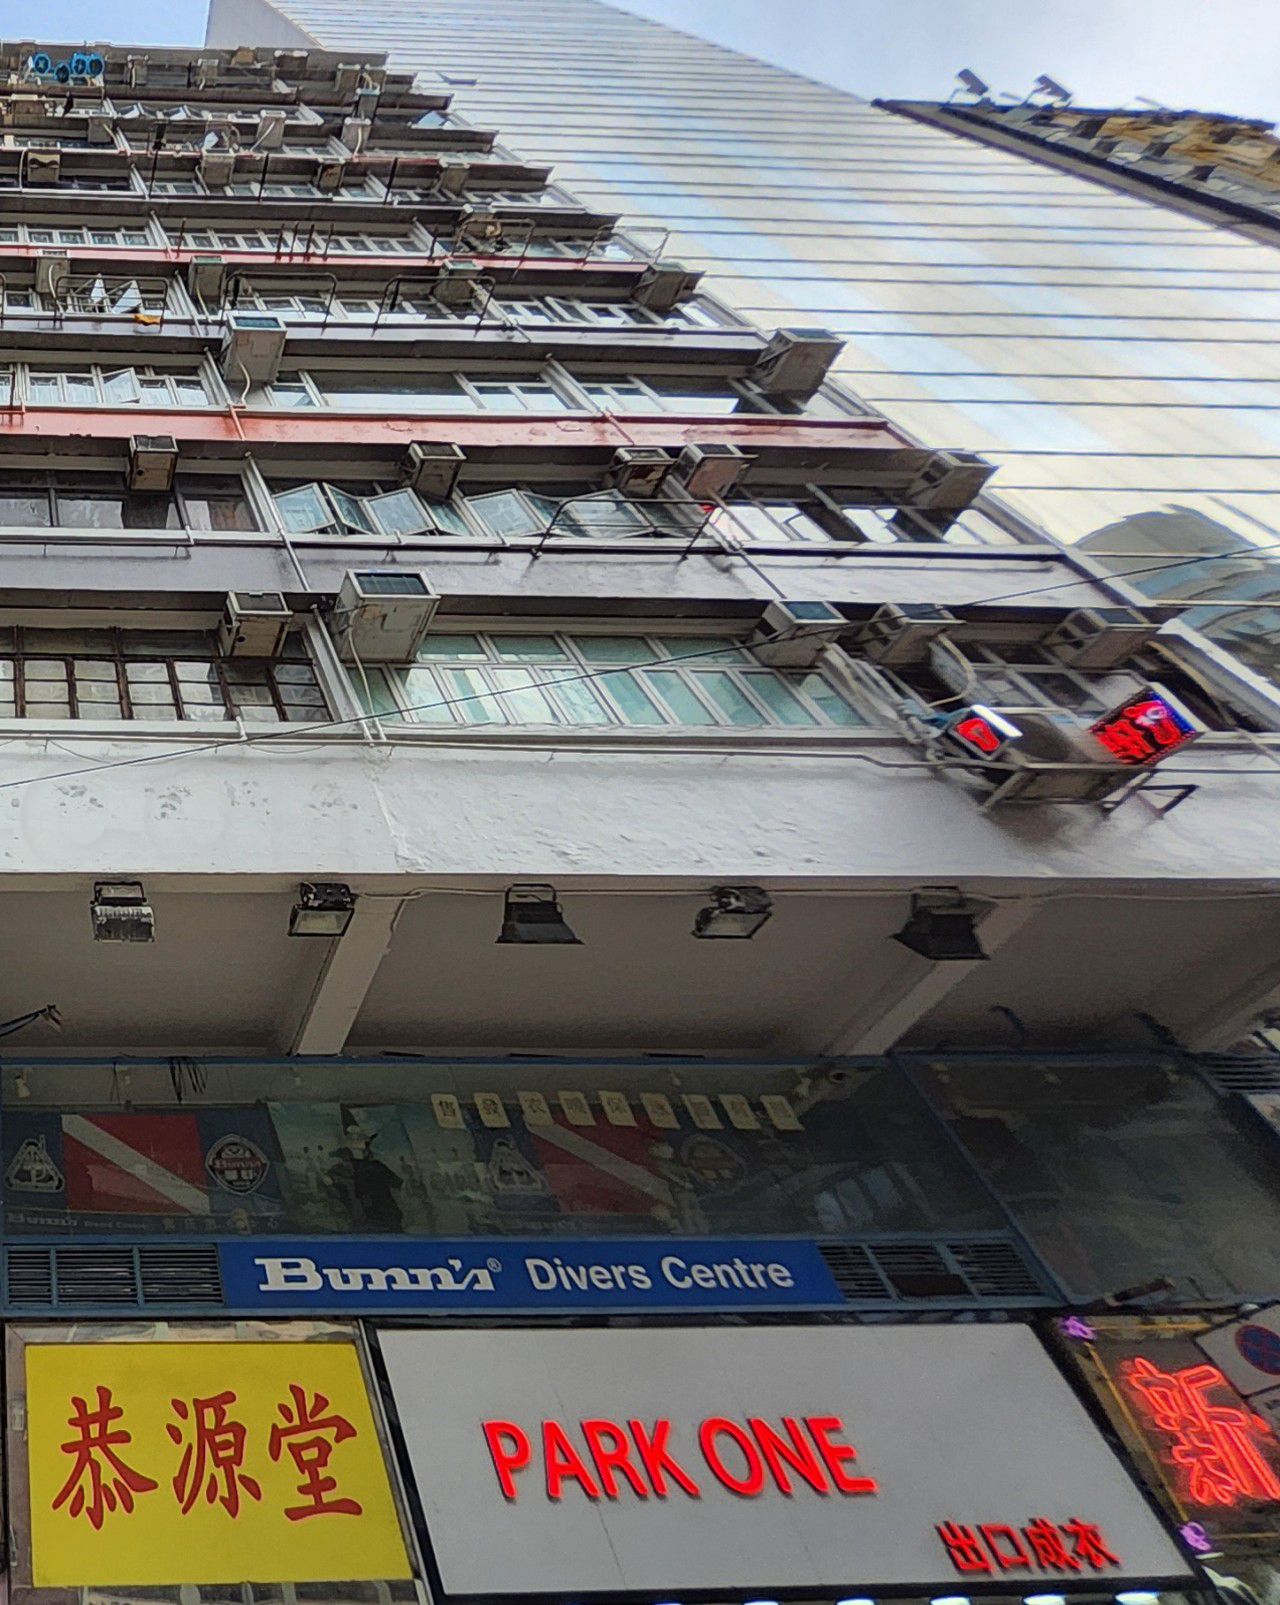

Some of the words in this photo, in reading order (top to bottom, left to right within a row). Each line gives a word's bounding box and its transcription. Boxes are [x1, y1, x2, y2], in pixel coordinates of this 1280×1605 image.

[525, 1257, 647, 1291] Divers
[660, 1255, 795, 1289] Centre
[52, 1384, 363, 1531] 恭源堂
[481, 1418, 700, 1499] PARK
[698, 1415, 879, 1497] ONE
[934, 1517, 1121, 1573] 出口成衣
